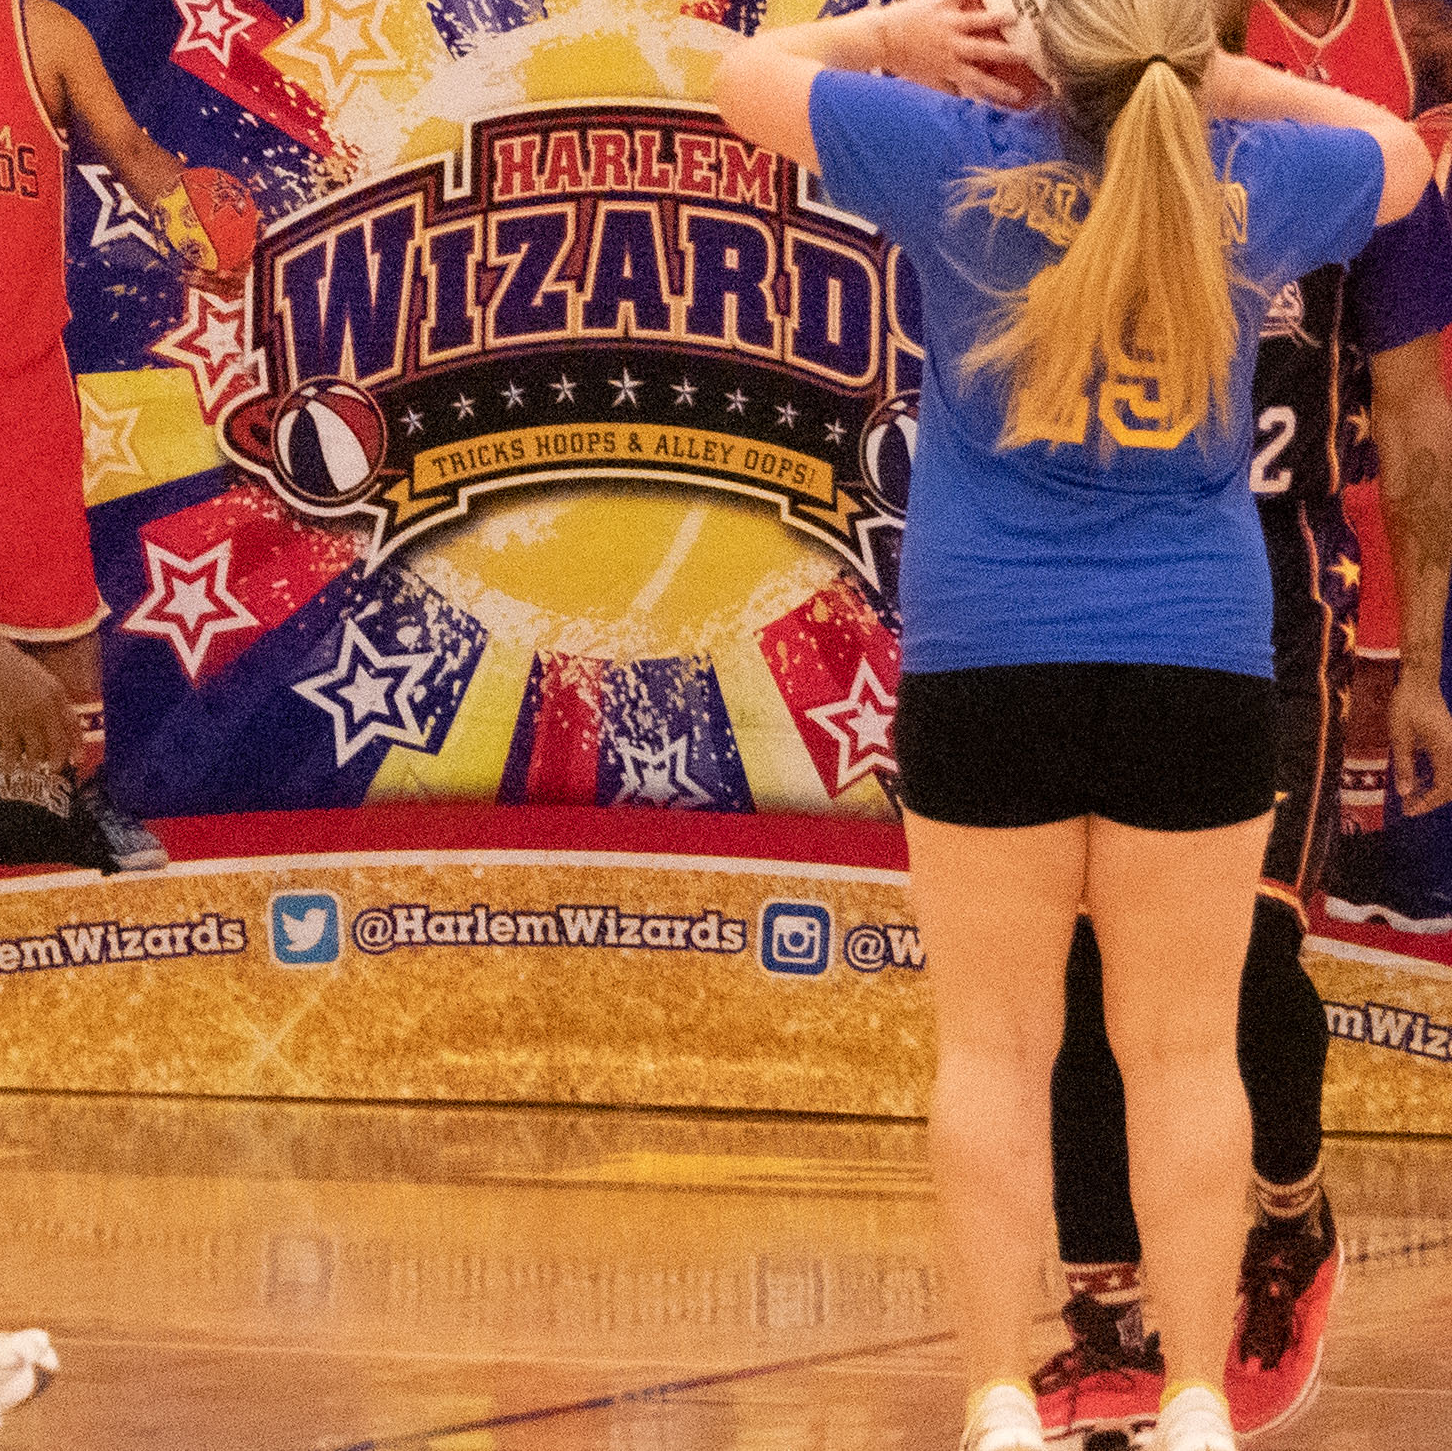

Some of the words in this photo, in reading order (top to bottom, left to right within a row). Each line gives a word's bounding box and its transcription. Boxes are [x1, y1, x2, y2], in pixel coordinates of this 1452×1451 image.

[493, 127, 779, 209] HARLEM
[431, 436, 526, 479] TRICKS
[535, 431, 617, 458] HOOPS
[628, 432, 645, 454] &
[655, 432, 736, 466] ALLEY
[746, 447, 818, 489] OOPS!
[1249, 405, 1297, 494] 2
[354, 906, 748, 956] @HarlemWizards
